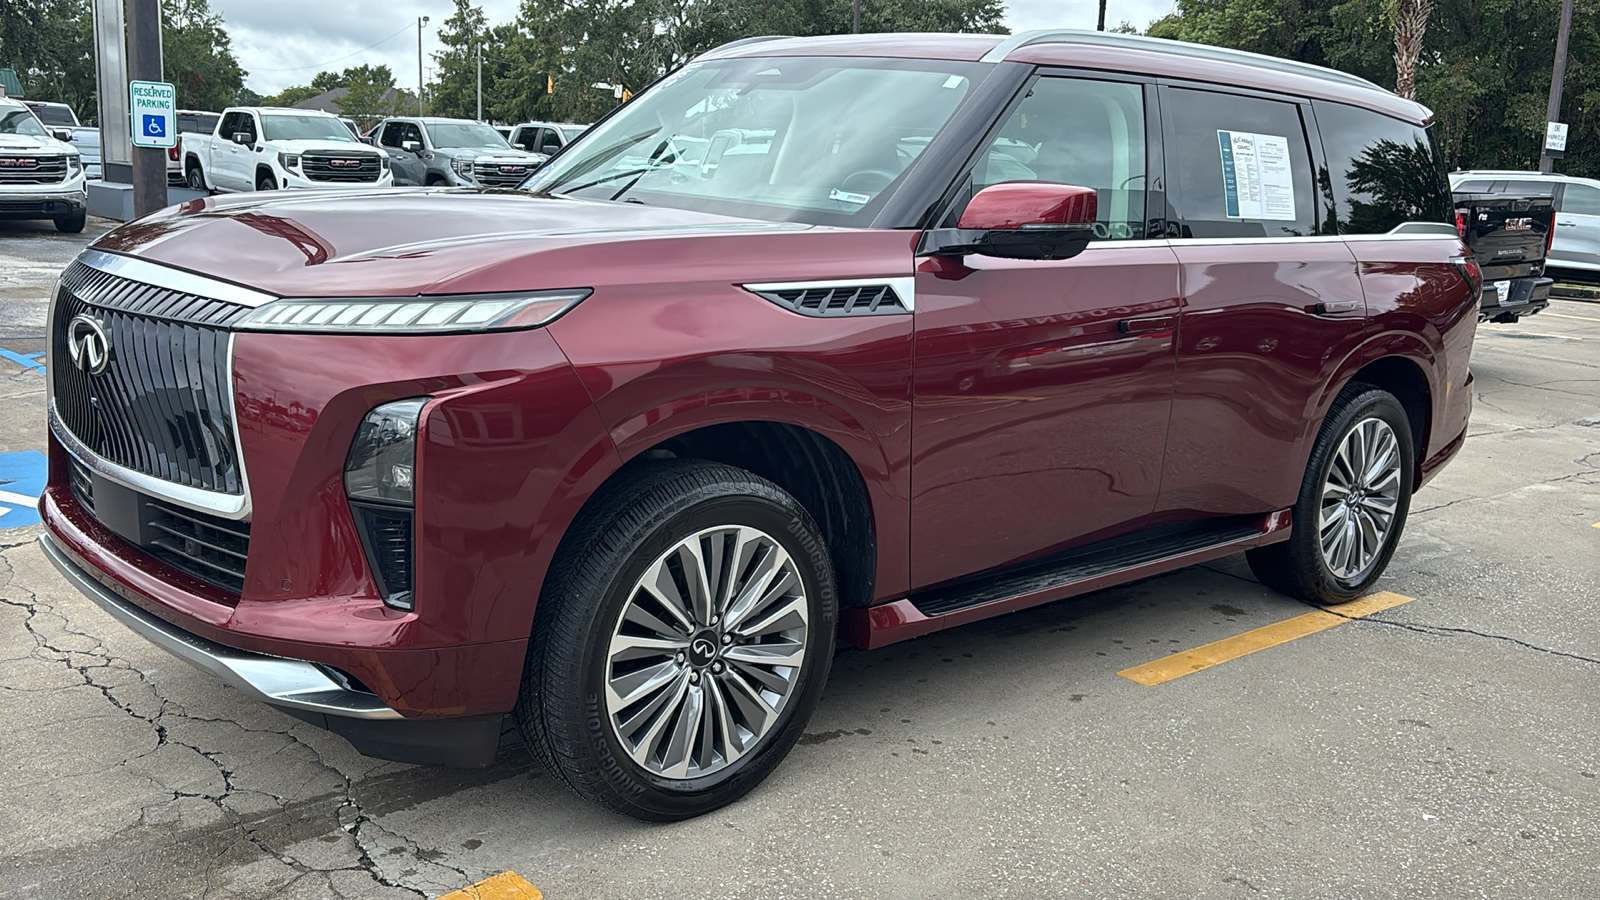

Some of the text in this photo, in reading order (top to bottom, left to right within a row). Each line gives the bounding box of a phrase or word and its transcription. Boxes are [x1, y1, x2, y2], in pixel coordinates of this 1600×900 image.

[134, 88, 172, 98] RESERVED
[137, 99, 170, 109] PARKING
[0, 158, 36, 166] GMC
[331, 159, 360, 167] GMC
[1505, 217, 1532, 231] GMC
[787, 516, 834, 621] BRIDGESTONE
[585, 692, 647, 798] BRIDGESTONE
